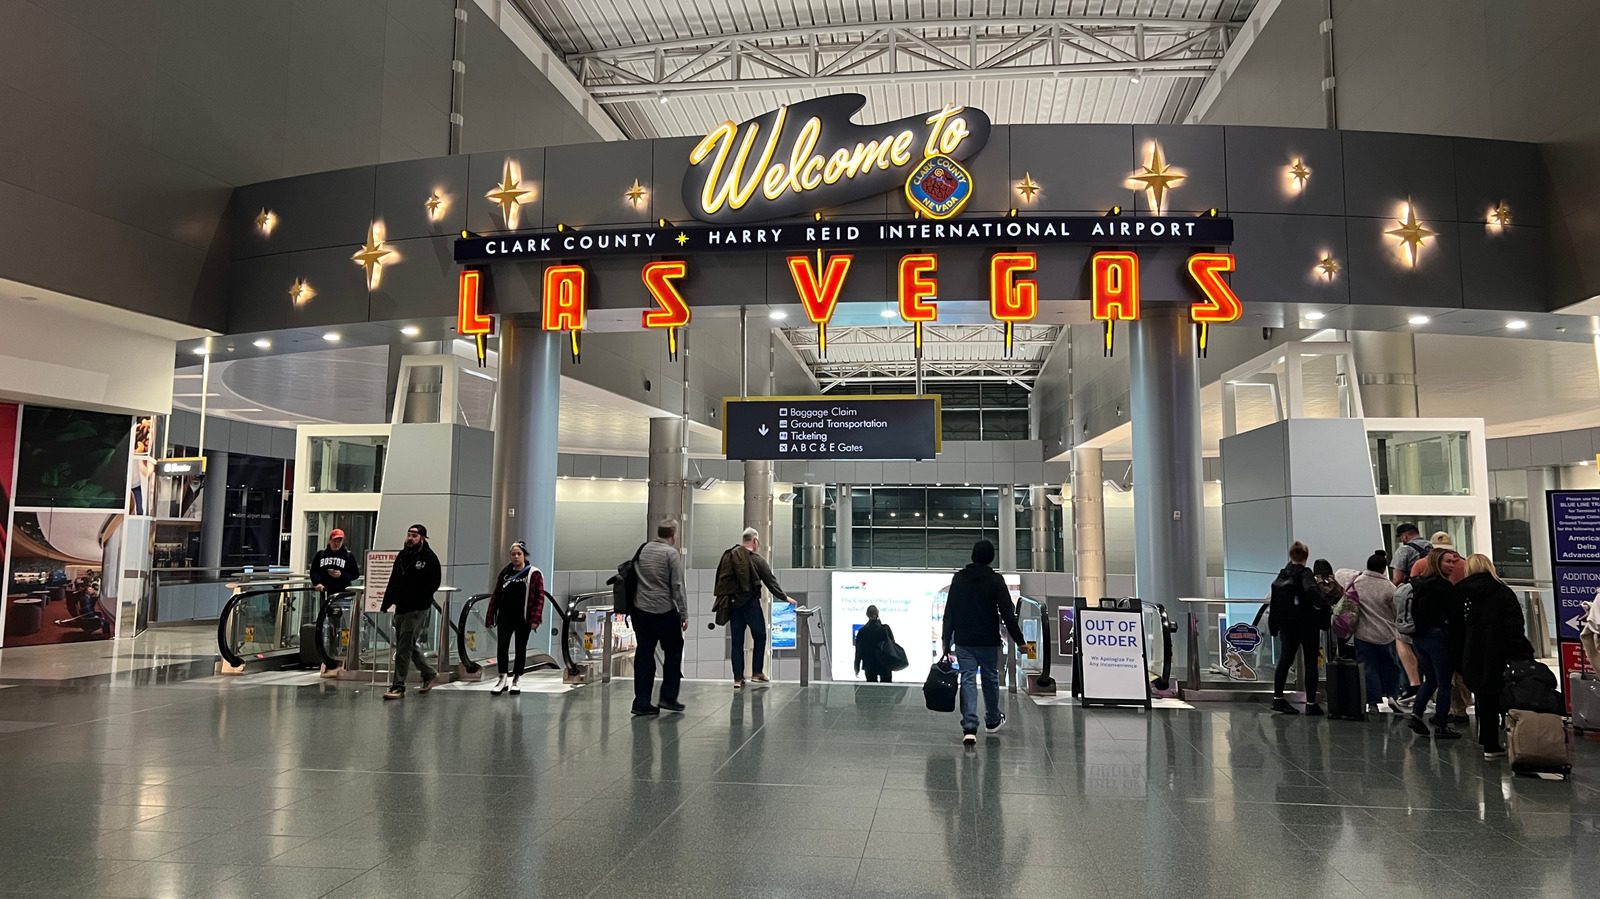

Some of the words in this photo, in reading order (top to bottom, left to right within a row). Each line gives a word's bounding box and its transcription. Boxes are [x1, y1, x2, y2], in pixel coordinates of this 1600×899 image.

[689, 103, 913, 214] Welcome
[924, 102, 970, 157] to
[913, 160, 936, 186] CLARK
[936, 158, 967, 184] COUNTY
[922, 196, 959, 212] NEVADA
[485, 237, 551, 255] CLARK
[563, 233, 657, 251] COUNTY
[708, 228, 783, 244] HARRY
[806, 226, 861, 242] REID
[879, 222, 1071, 240] INTERNATIONAL
[1091, 221, 1196, 237] AIRPORT
[457, 260, 692, 335] LAS
[785, 251, 1244, 323] VEGAS
[790, 407, 829, 418] Baggage
[831, 406, 857, 416] Claim
[790, 419, 824, 428] Ground
[826, 418, 888, 430] Transportation
[790, 430, 828, 442] Ticketing
[790, 443, 798, 452] A
[800, 443, 807, 452] B
[808, 442, 817, 452] C
[819, 442, 827, 452] &
[829, 442, 835, 452] E
[837, 442, 864, 452] Gates
[320, 556, 346, 568] BOSTON
[1085, 619, 1114, 632] OUT
[1118, 620, 1136, 632] OF
[1086, 634, 1138, 648] ORDER
